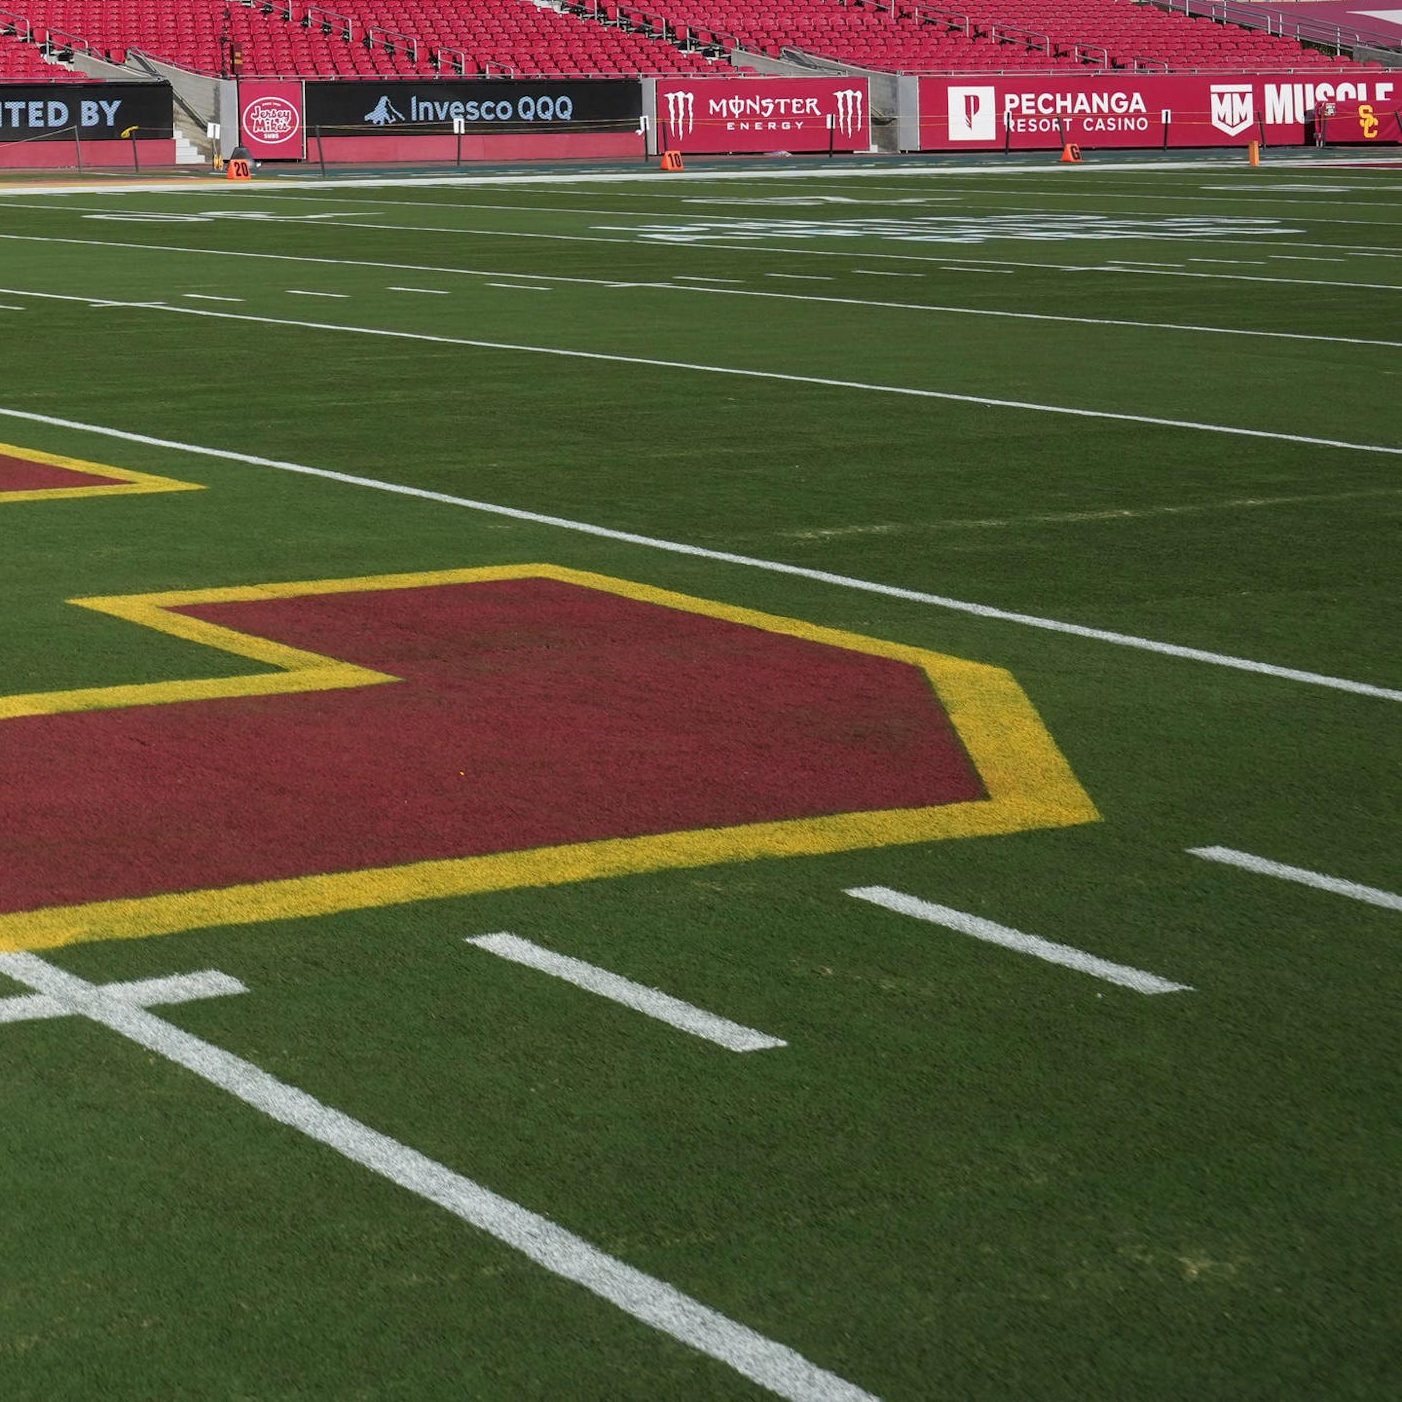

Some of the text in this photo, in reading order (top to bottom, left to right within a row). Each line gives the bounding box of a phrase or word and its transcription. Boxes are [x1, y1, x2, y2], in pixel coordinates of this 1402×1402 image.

[411, 95, 573, 122] Invesco QQQ
[709, 95, 822, 119] MONSTER
[1004, 92, 1147, 115] PECHANGA
[80, 100, 122, 128] BY
[251, 105, 292, 123] Jersey
[1358, 104, 1379, 139] SC
[726, 121, 805, 131] ENERGY
[1083, 117, 1149, 132] CASINO
[667, 153, 682, 168] 10
[1070, 145, 1081, 161] G
[233, 161, 249, 177] 20
